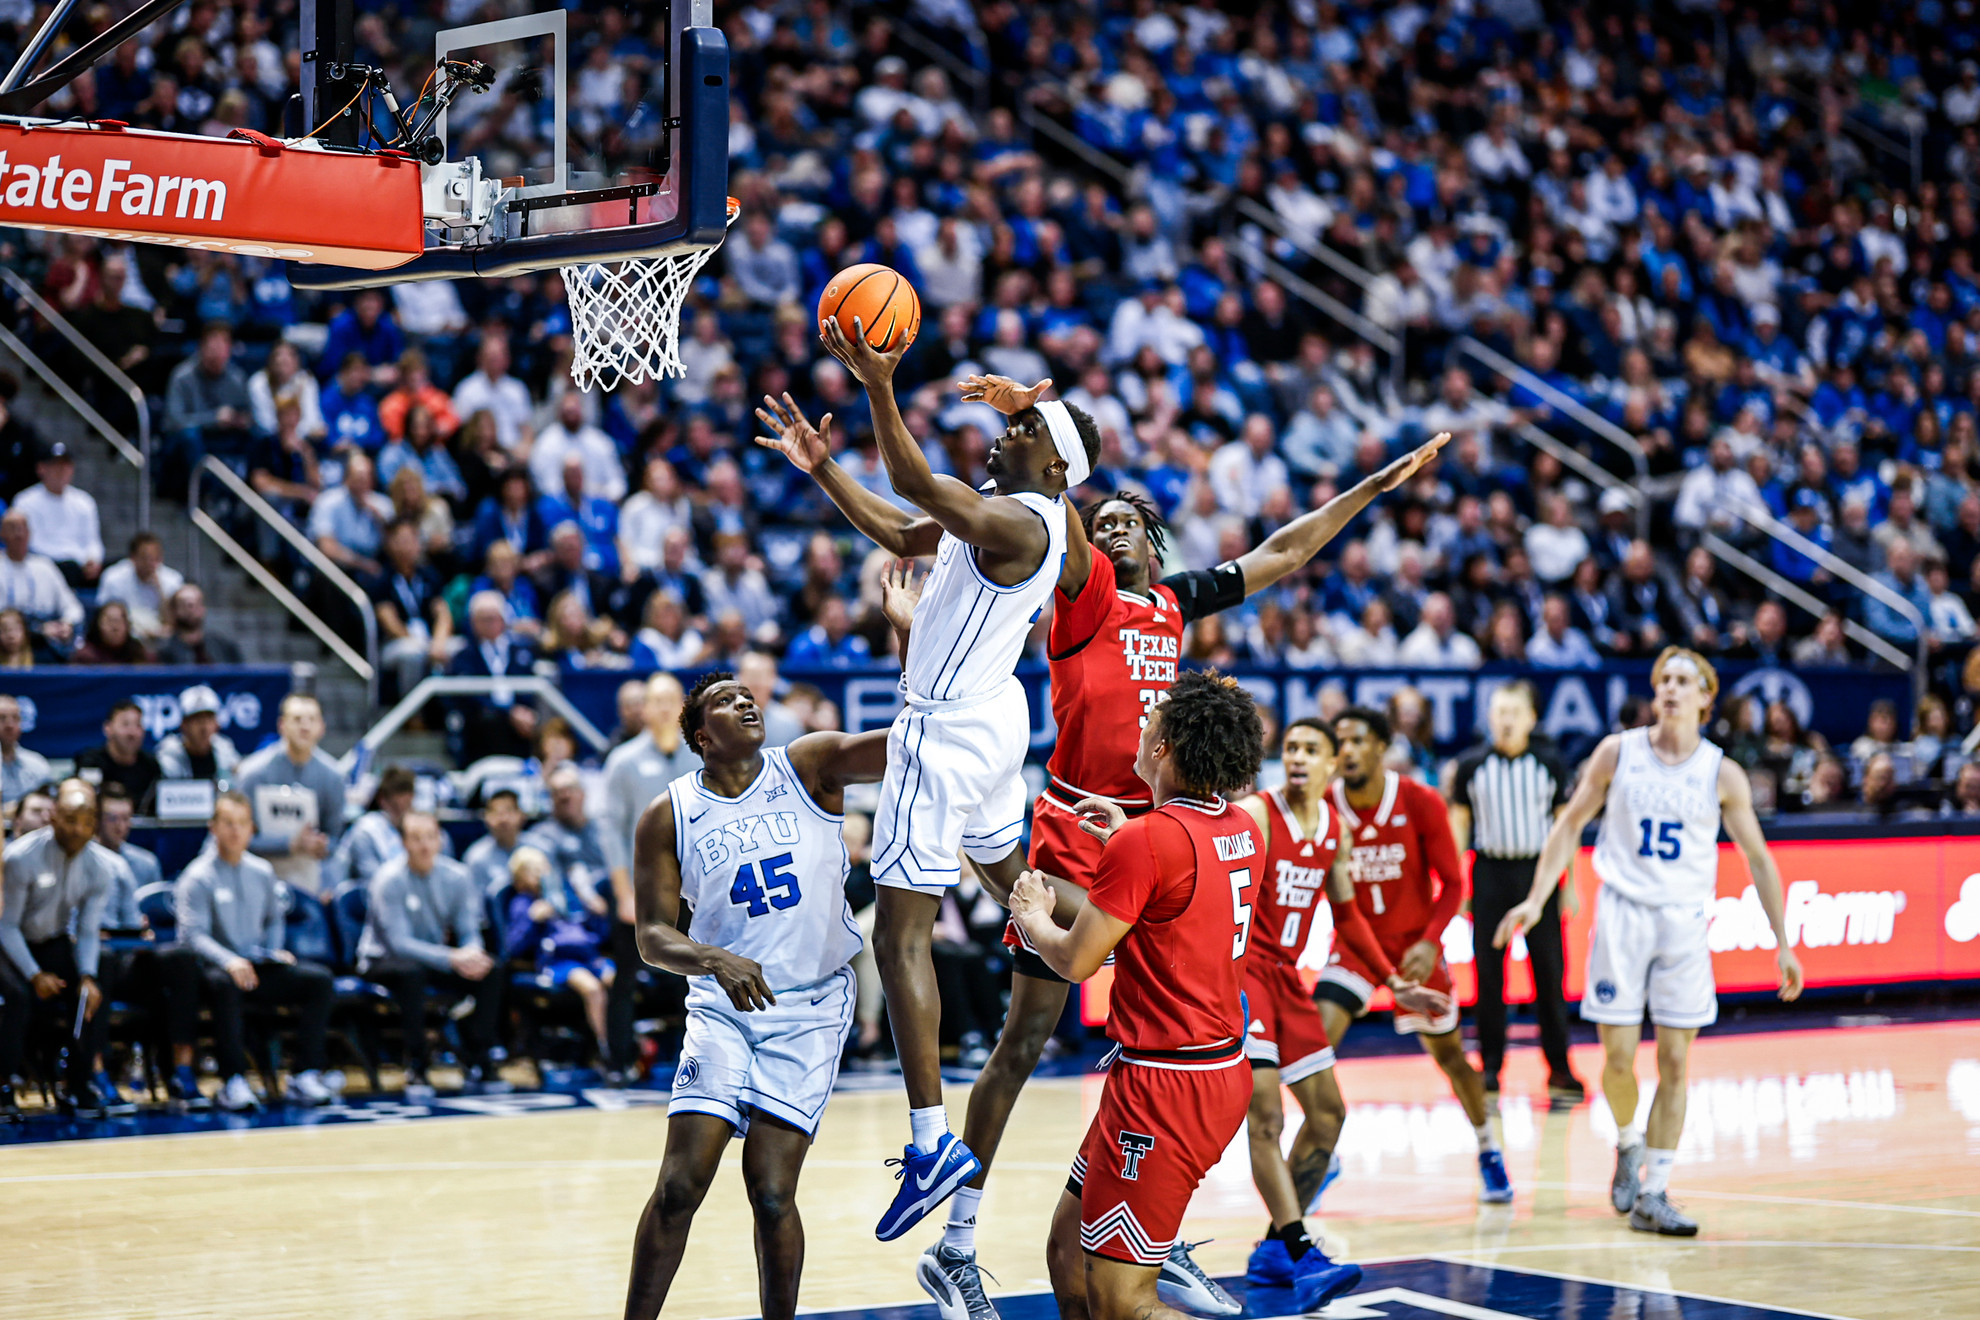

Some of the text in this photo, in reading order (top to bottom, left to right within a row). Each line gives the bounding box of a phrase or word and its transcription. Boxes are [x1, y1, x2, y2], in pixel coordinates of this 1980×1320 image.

[95, 158, 227, 221] Farm
[1119, 628, 1178, 658] TEXAS
[1126, 654, 1176, 682] TECH
[694, 812, 801, 876] BYU
[1638, 818, 1684, 861] 15
[730, 852, 802, 918] 45
[1276, 859, 1325, 888] TEXAS
[1228, 867, 1252, 961] 5
[1276, 884, 1315, 908] TECH
[1370, 883, 1385, 914] 1
[1280, 911, 1301, 947] 0
